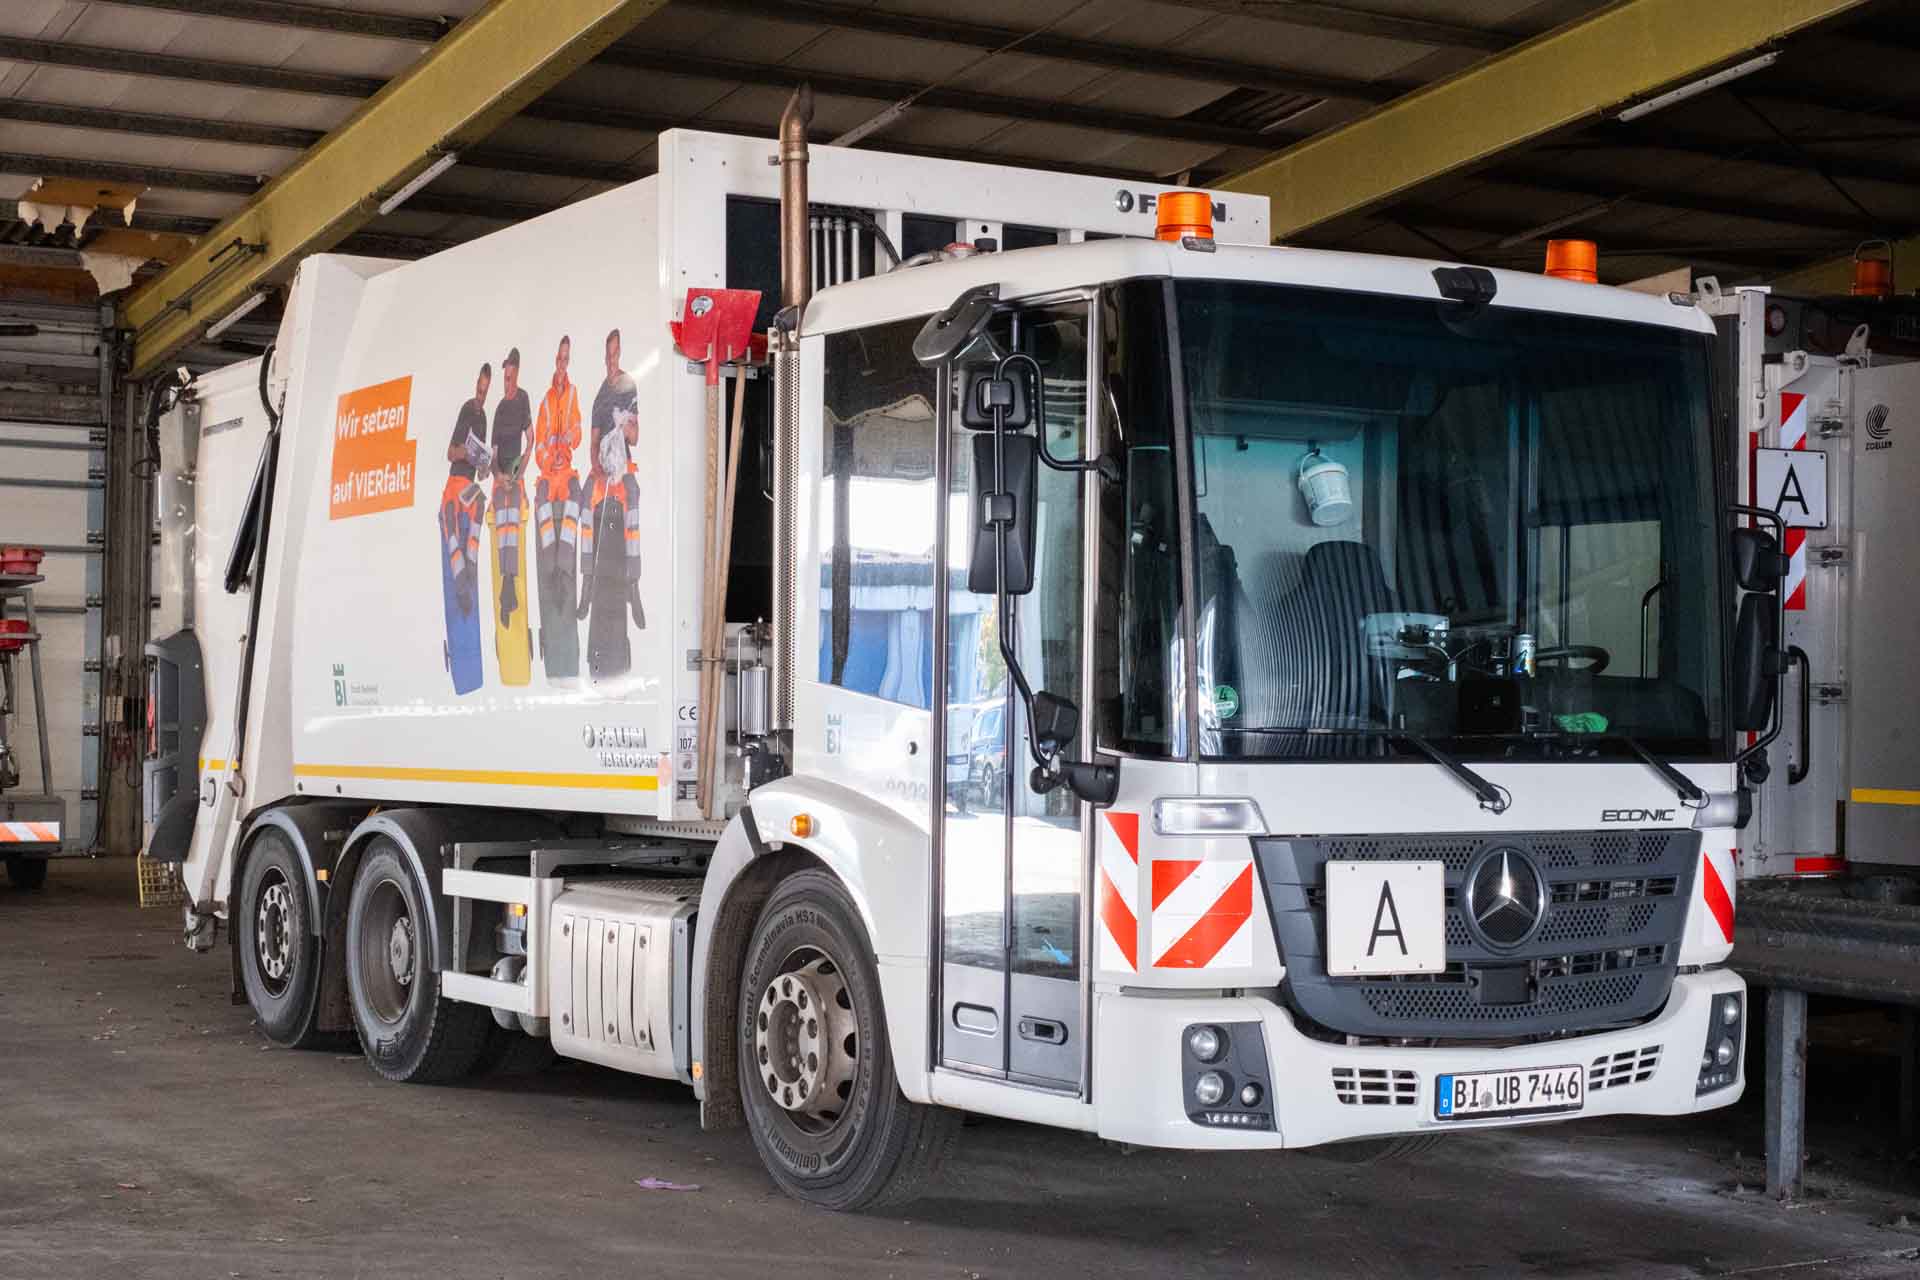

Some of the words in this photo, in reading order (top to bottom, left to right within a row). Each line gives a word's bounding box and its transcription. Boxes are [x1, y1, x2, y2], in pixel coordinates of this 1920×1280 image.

[1138, 194, 1226, 223] FN
[338, 409, 360, 441] Wir
[361, 404, 405, 435] setzen
[333, 471, 354, 505] auf
[355, 462, 411, 500] VIERfalt!
[1775, 463, 1809, 515] A
[679, 738, 693, 750] 107
[1601, 808, 1676, 823] ECONIC
[1366, 880, 1409, 957] A
[1454, 1079, 1479, 1109] BI
[1496, 1076, 1521, 1105] UB
[1528, 1071, 1579, 1102] 7446
